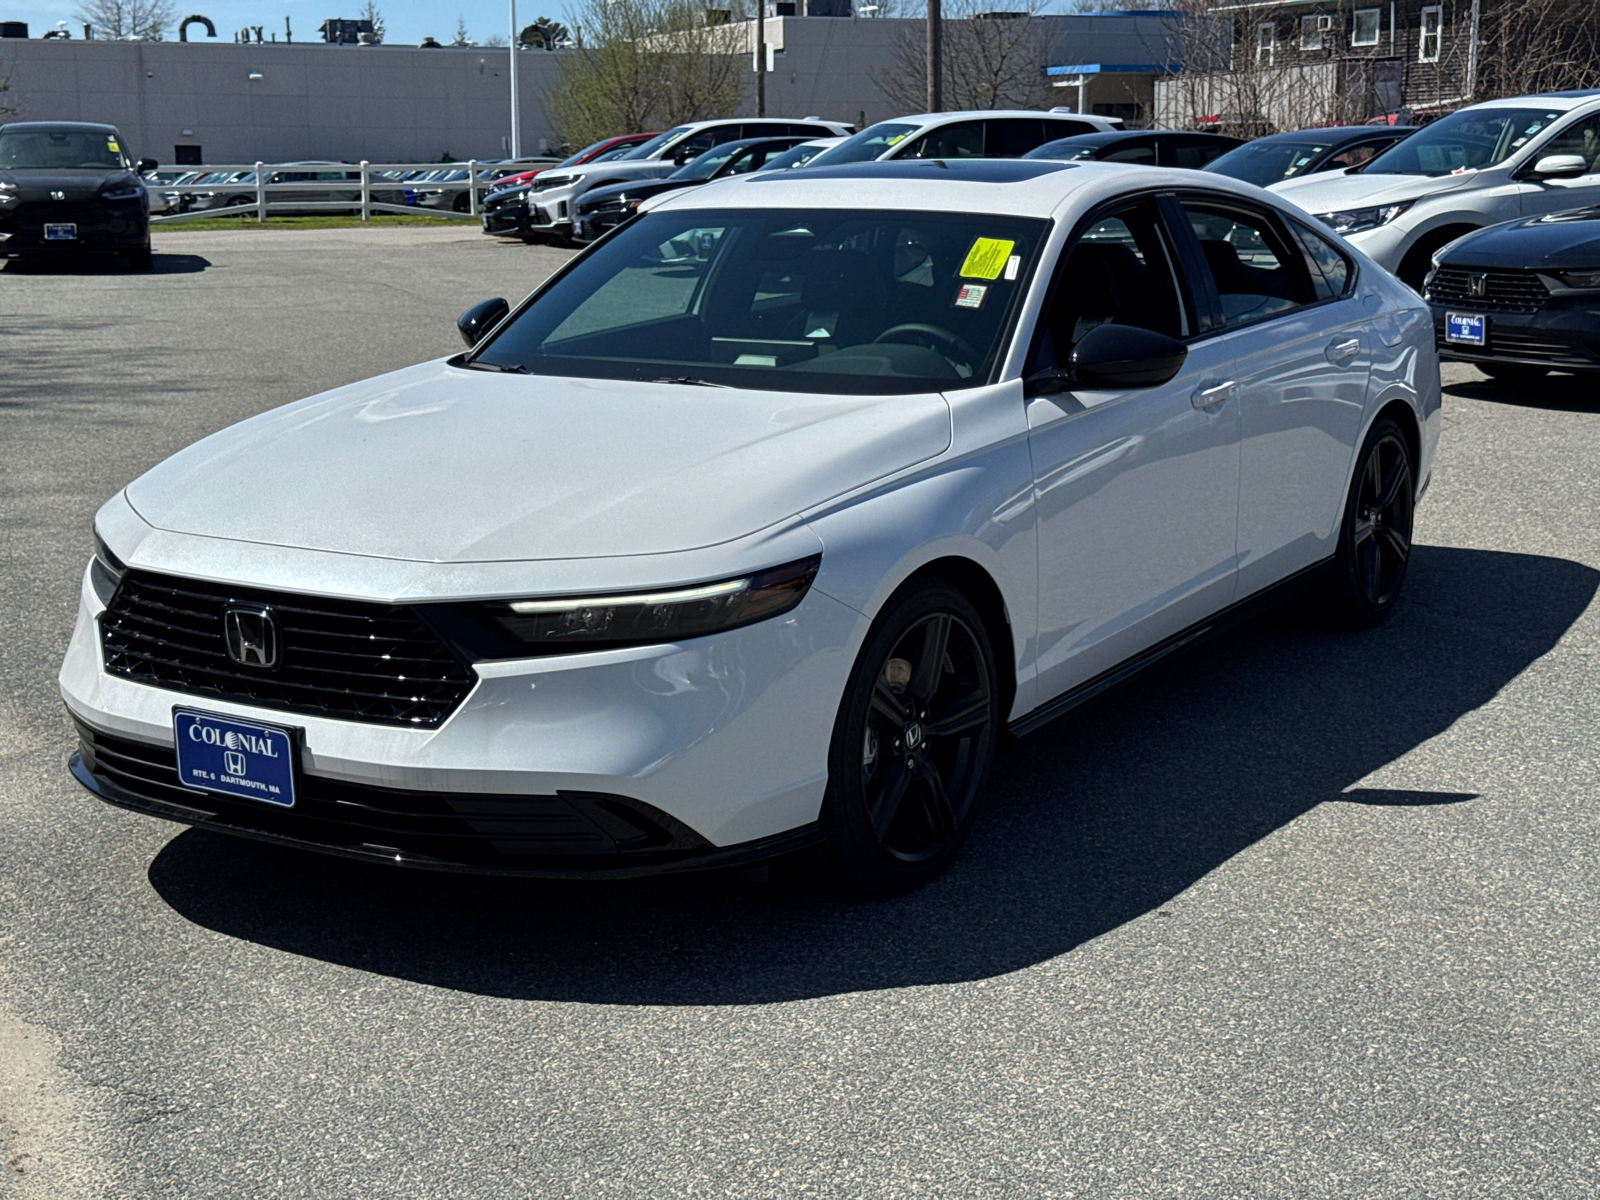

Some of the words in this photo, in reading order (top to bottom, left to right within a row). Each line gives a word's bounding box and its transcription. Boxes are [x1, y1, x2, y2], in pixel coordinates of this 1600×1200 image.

[189, 724, 278, 758] COLONIAL
[193, 769, 209, 779] RTE.
[221, 775, 267, 792] DARTMOUTH,
[269, 785, 281, 794] MA
